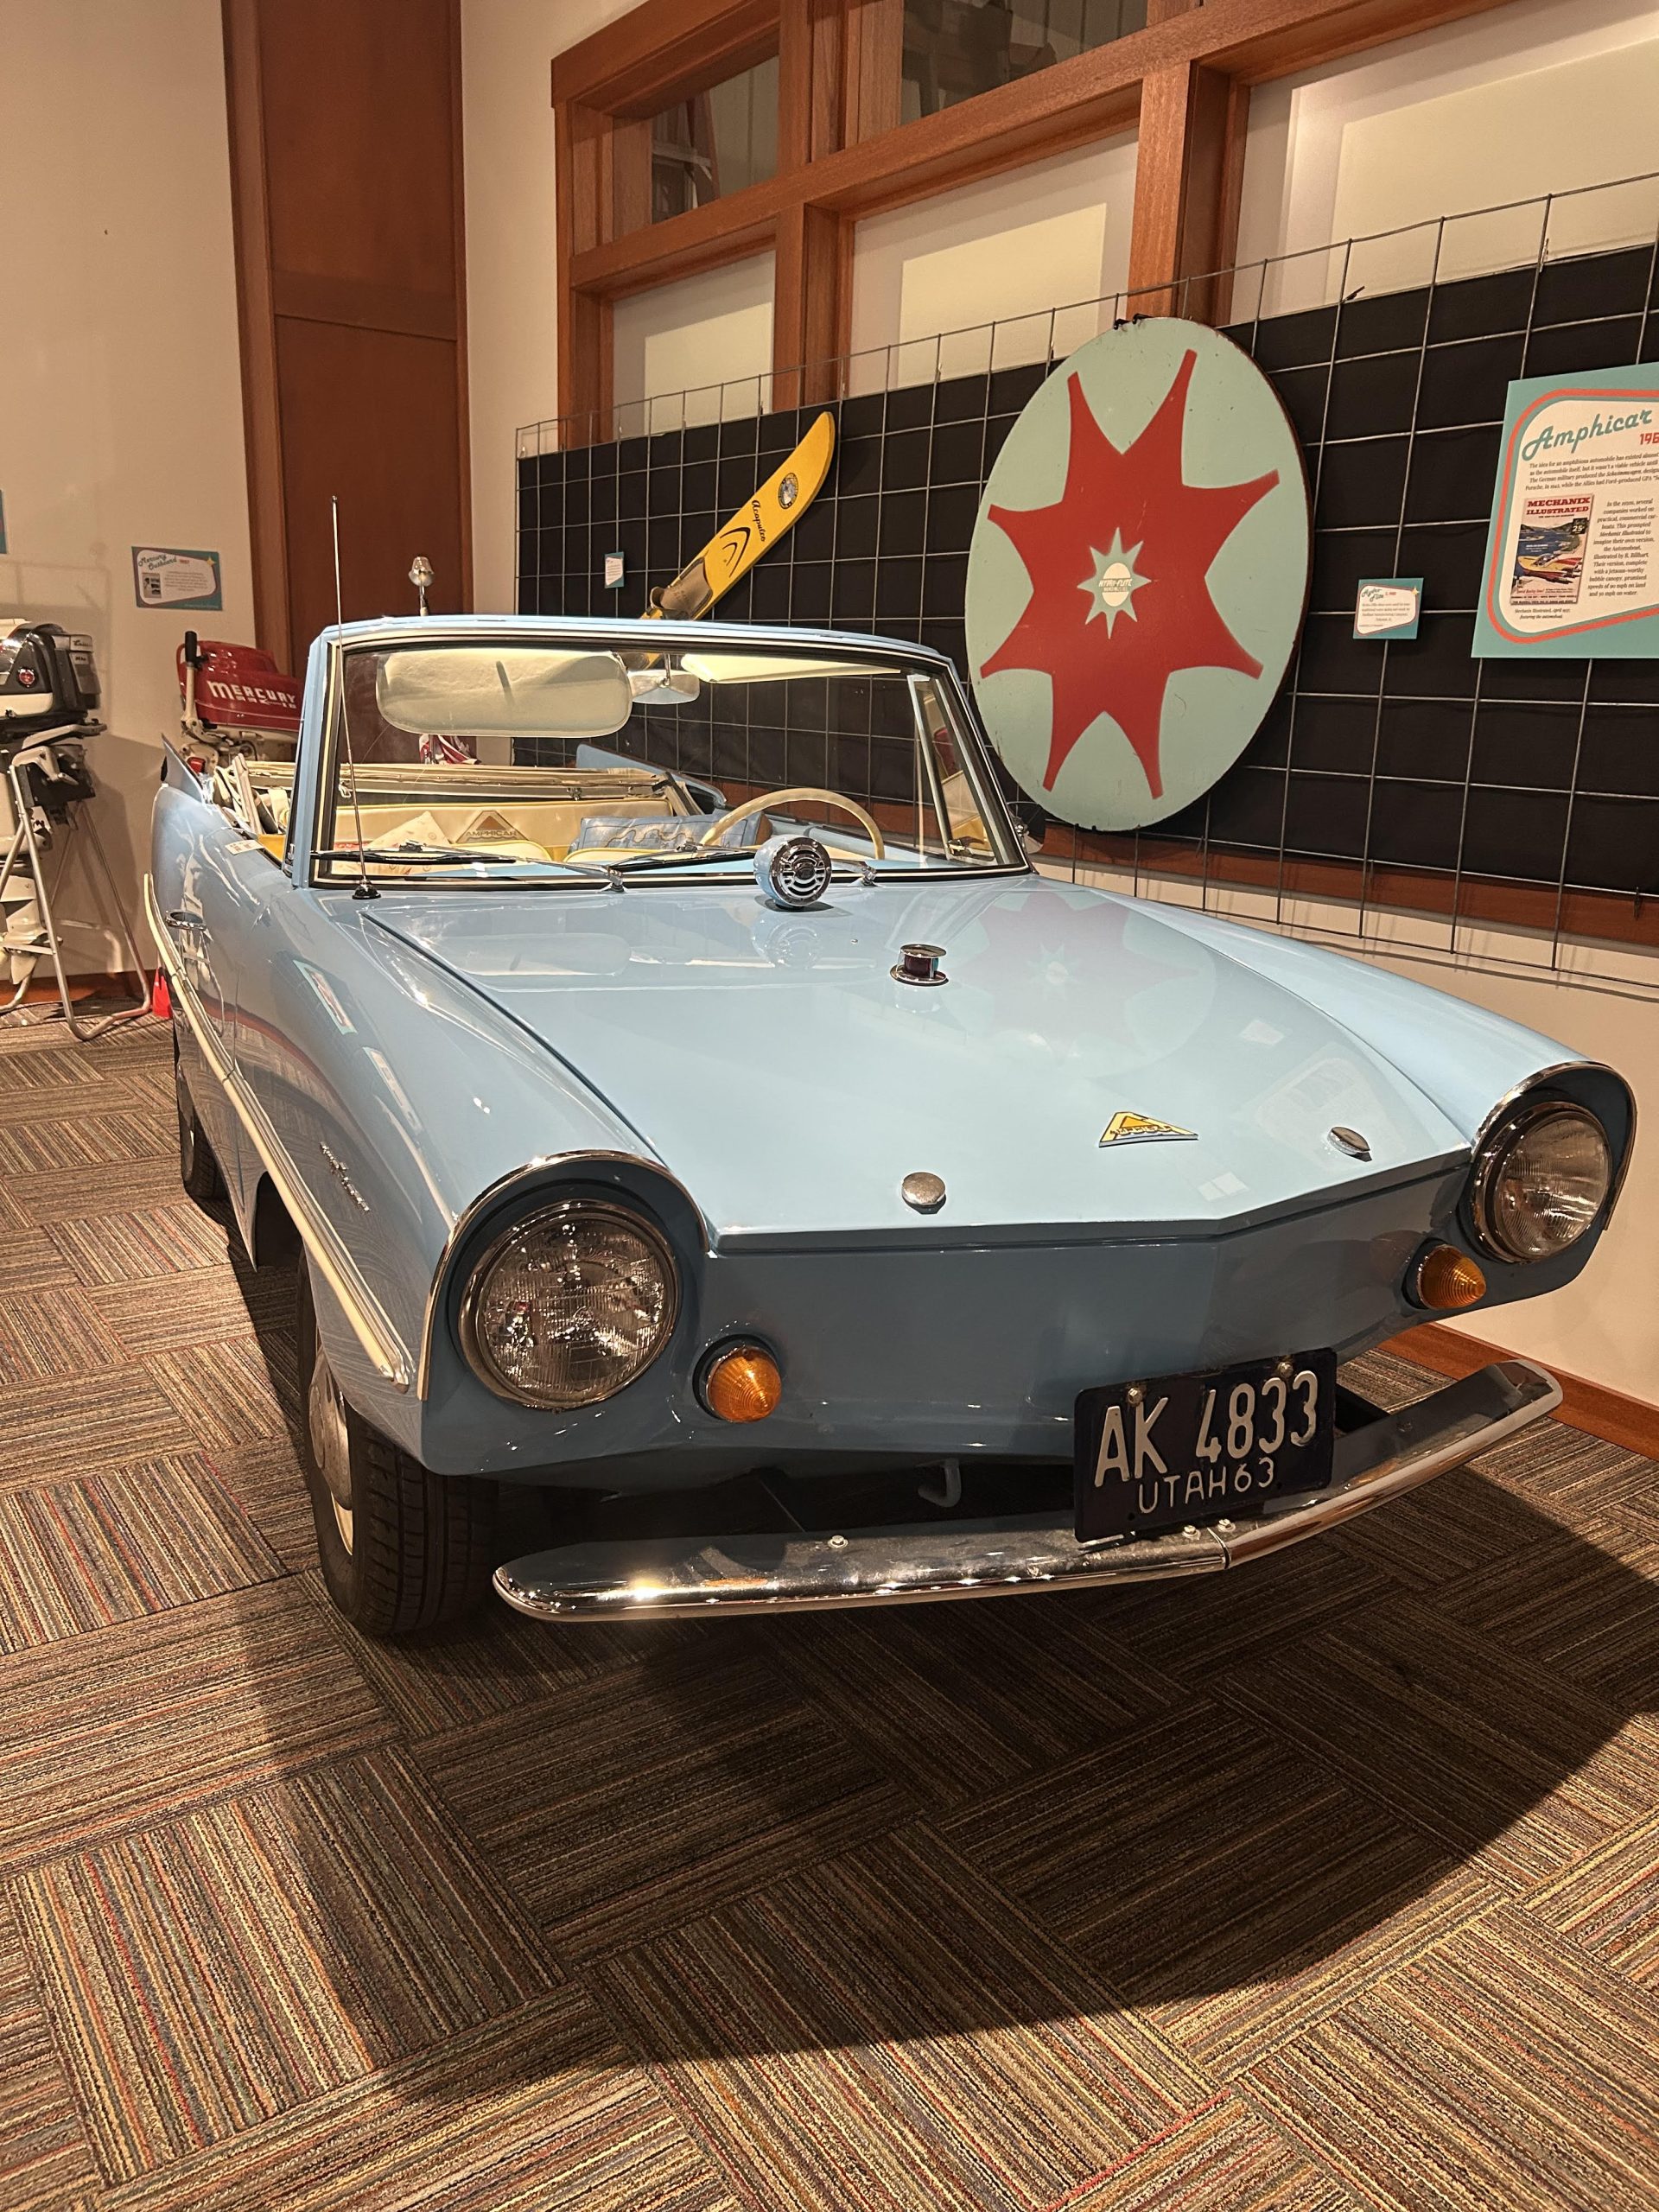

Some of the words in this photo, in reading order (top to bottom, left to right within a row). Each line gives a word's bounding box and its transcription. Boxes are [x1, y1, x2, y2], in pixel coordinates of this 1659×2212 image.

[1522, 410, 1653, 461] Amphicar
[751, 499, 766, 543] Acapulco
[1526, 506, 1589, 515] ILLUSTRATED
[1528, 498, 1590, 507] MECHANIX
[207, 680, 297, 709] MERCURY
[1094, 1396, 1169, 1489] AK
[1195, 1370, 1319, 1464] 4833
[1138, 1465, 1226, 1514] UTAH
